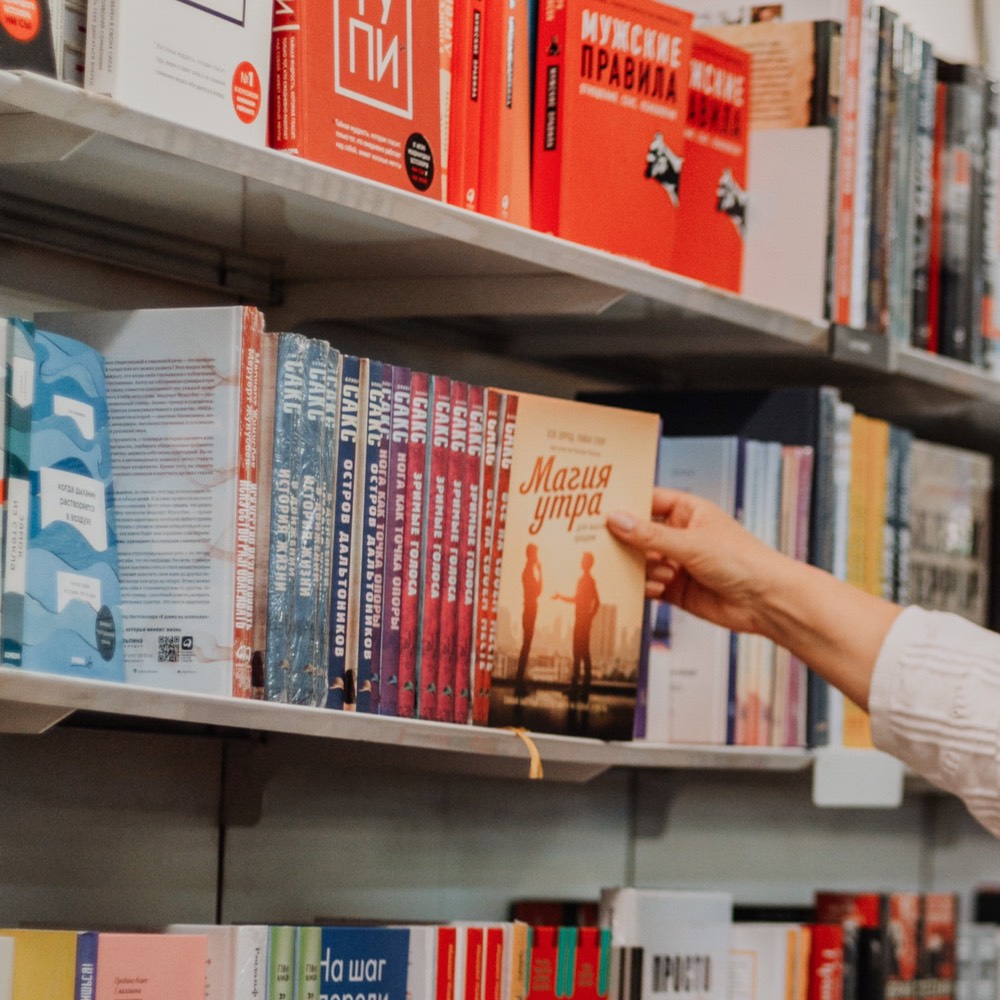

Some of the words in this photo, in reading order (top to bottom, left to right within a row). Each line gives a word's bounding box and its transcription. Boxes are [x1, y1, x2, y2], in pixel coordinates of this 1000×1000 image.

[350, 17, 398, 89] ПИ
[581, 9, 683, 69] МУЖСКИЕ
[580, 43, 678, 103] ПРАВИЛА
[282, 360, 304, 415] САКС
[307, 368, 326, 421] САКС
[340, 384, 361, 443] САКС
[367, 389, 385, 446] САКС
[392, 391, 411, 444] САКС
[410, 397, 428, 445] САКС
[433, 401, 451, 449] САКС
[450, 406, 468, 453] САКС
[467, 410, 484, 457] САКС
[341, 459, 354, 524] ОСТРОВ
[367, 463, 379, 528] ОСТРОВ
[379, 449, 389, 488] НОГА
[396, 452, 407, 489] НОГА
[519, 455, 613, 495] Магия
[278, 469, 291, 534] ИСТОРИЯ
[301, 475, 315, 540] ИСТОРИЯ
[377, 491, 387, 519] КАК
[394, 494, 405, 521] КАК
[410, 472, 423, 535] ЗРИМЫЕ
[432, 475, 446, 538] ЗРИМЫЕ
[450, 480, 463, 542] ЗРИМЫЕ
[466, 484, 479, 546] ЗРИМЫЕ
[528, 492, 604, 536] утра
[274, 541, 288, 593] ЖИЗНИ
[299, 547, 314, 597] ЖИЗНИ
[374, 523, 386, 569] ТОЧКА
[392, 526, 404, 572] ТОЧКА
[407, 541, 420, 597] ГОЛОСА
[430, 543, 443, 599] ГОЛОСА
[334, 530, 350, 658] ДАЛЬТОНИКОВ
[363, 534, 377, 661] ДАЛЬТОНИКОВ
[372, 573, 383, 628] ОПОРЫ
[446, 547, 460, 603] ГОЛОСА
[463, 551, 477, 605] ГОЛОСА
[390, 576, 402, 630] ОПОРЫ
[349, 958, 387, 982] шаг
